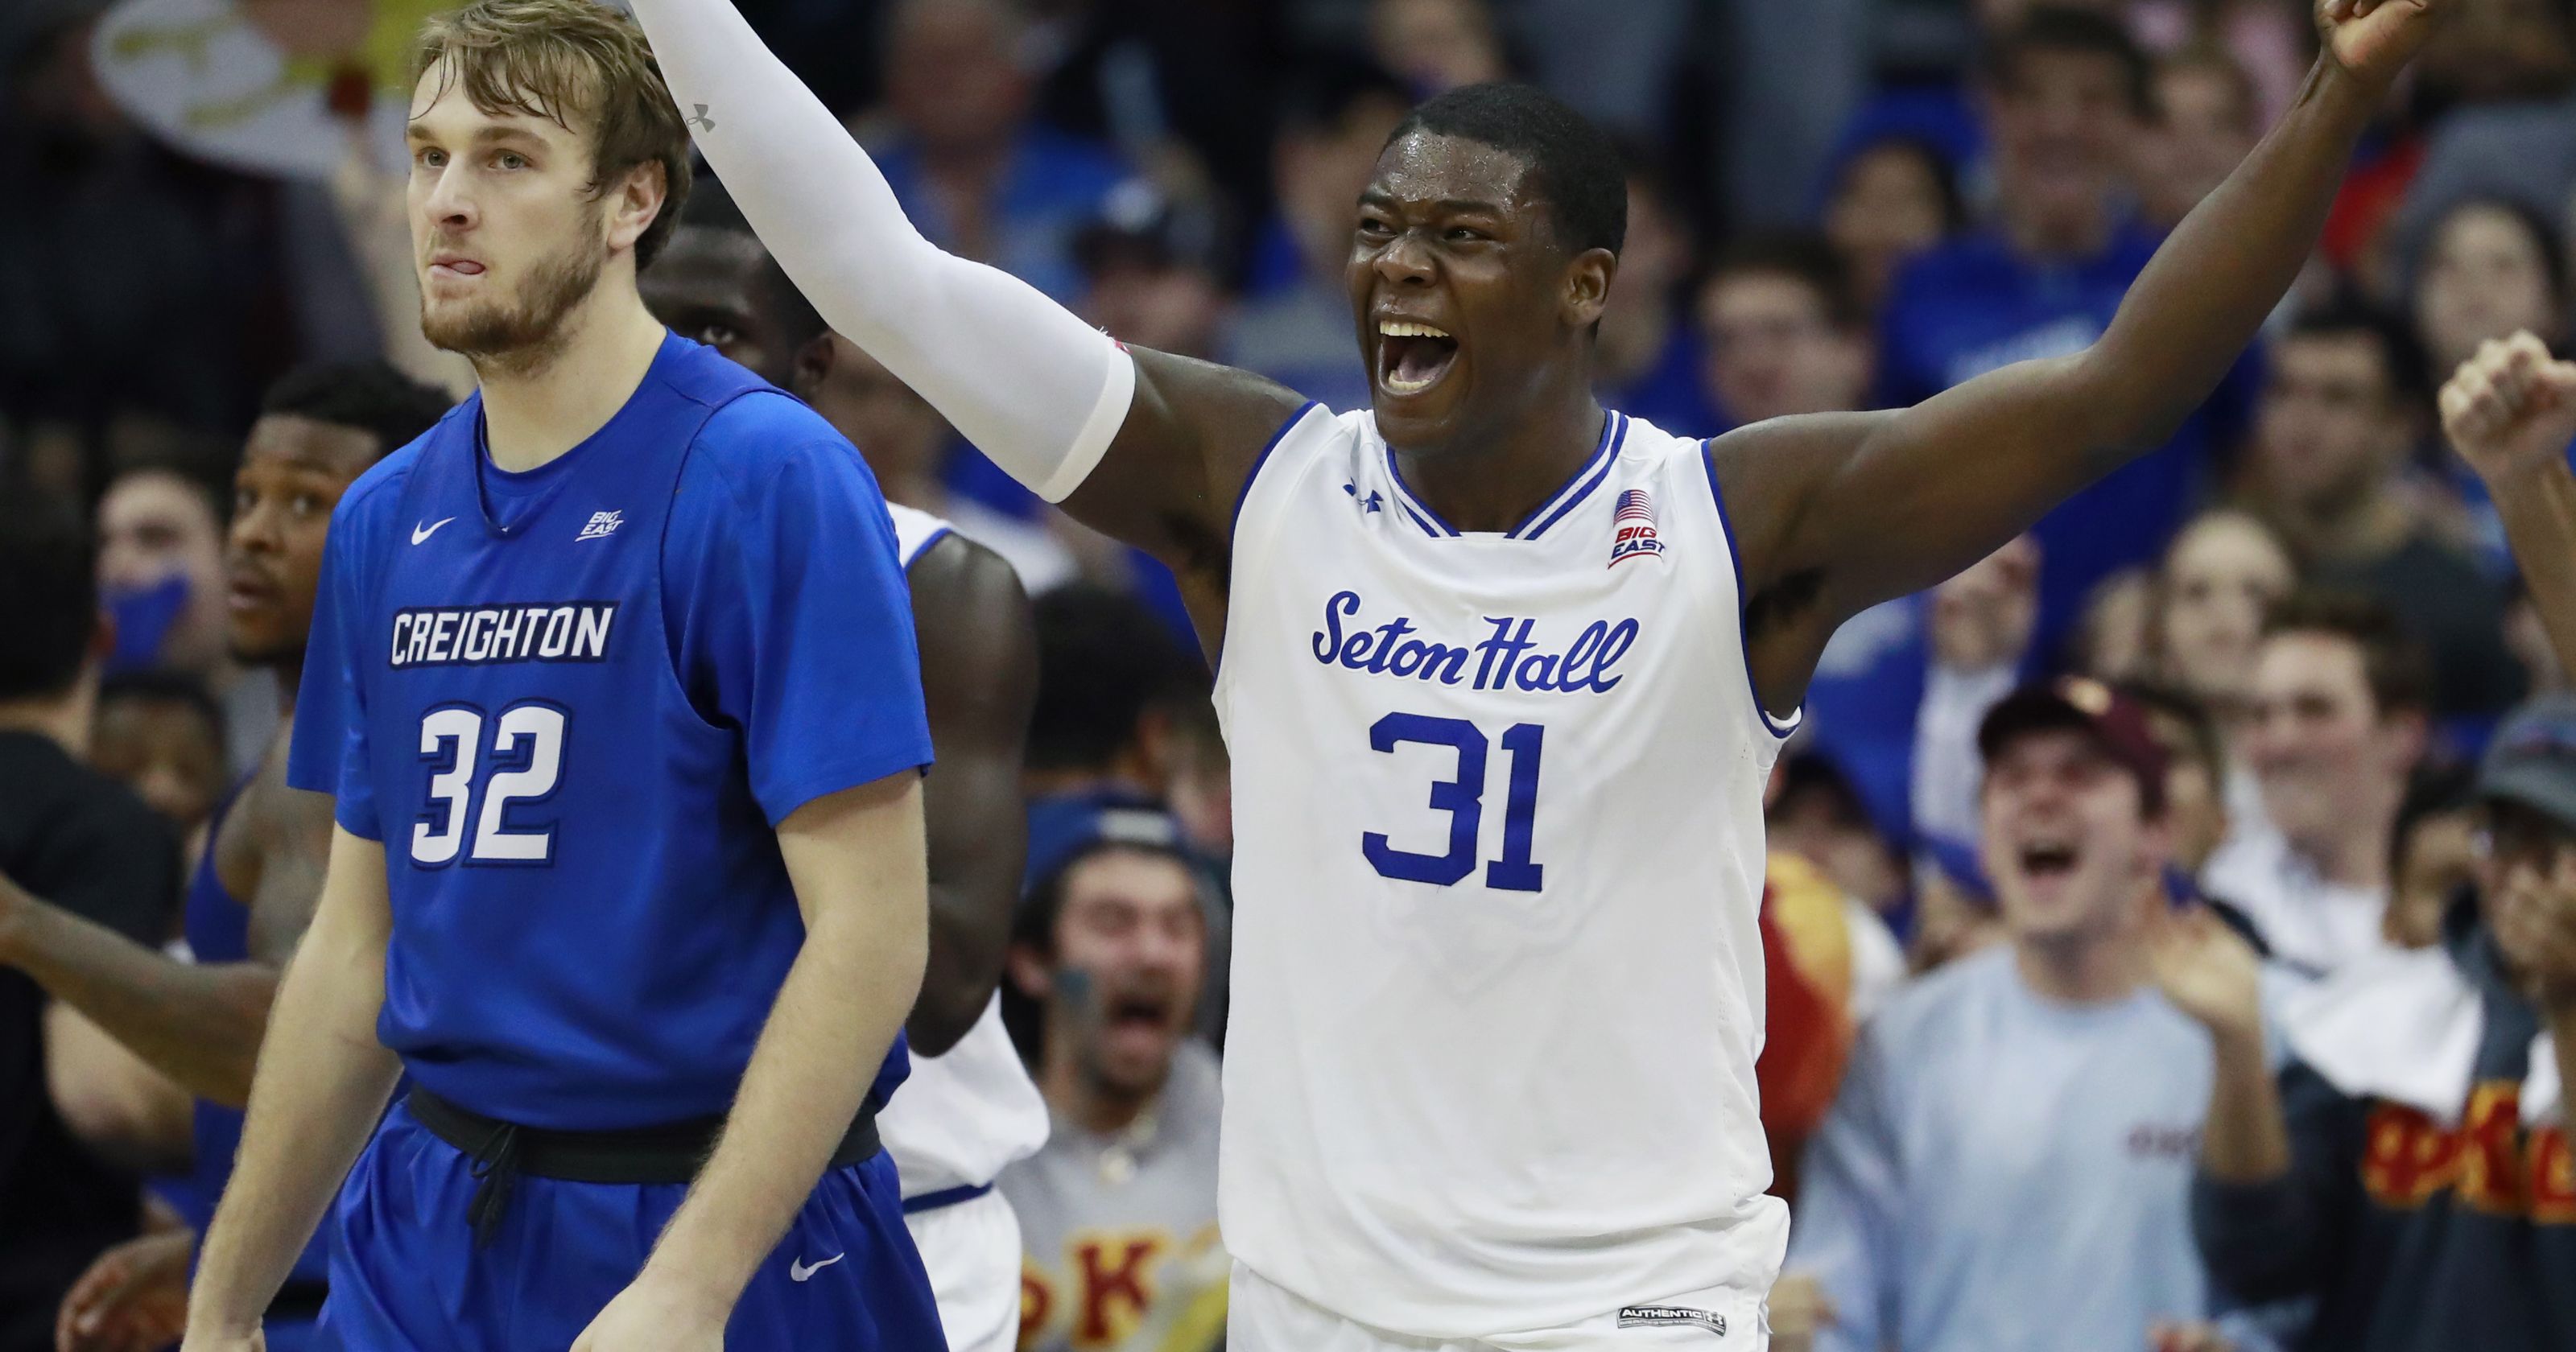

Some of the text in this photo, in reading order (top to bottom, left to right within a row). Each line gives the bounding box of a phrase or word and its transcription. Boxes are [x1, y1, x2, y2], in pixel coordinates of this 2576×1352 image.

[588, 509, 622, 523] BIG
[580, 520, 624, 535] EAST
[1615, 526, 1657, 544] BIG
[1611, 539, 1666, 559] EAST
[390, 606, 613, 666] CREIGHTON
[1312, 590, 1640, 694] Seton Hall
[411, 705, 565, 864] 32
[1362, 711, 1545, 893] 31
[1621, 1309, 1703, 1318] AUTHENTIC
